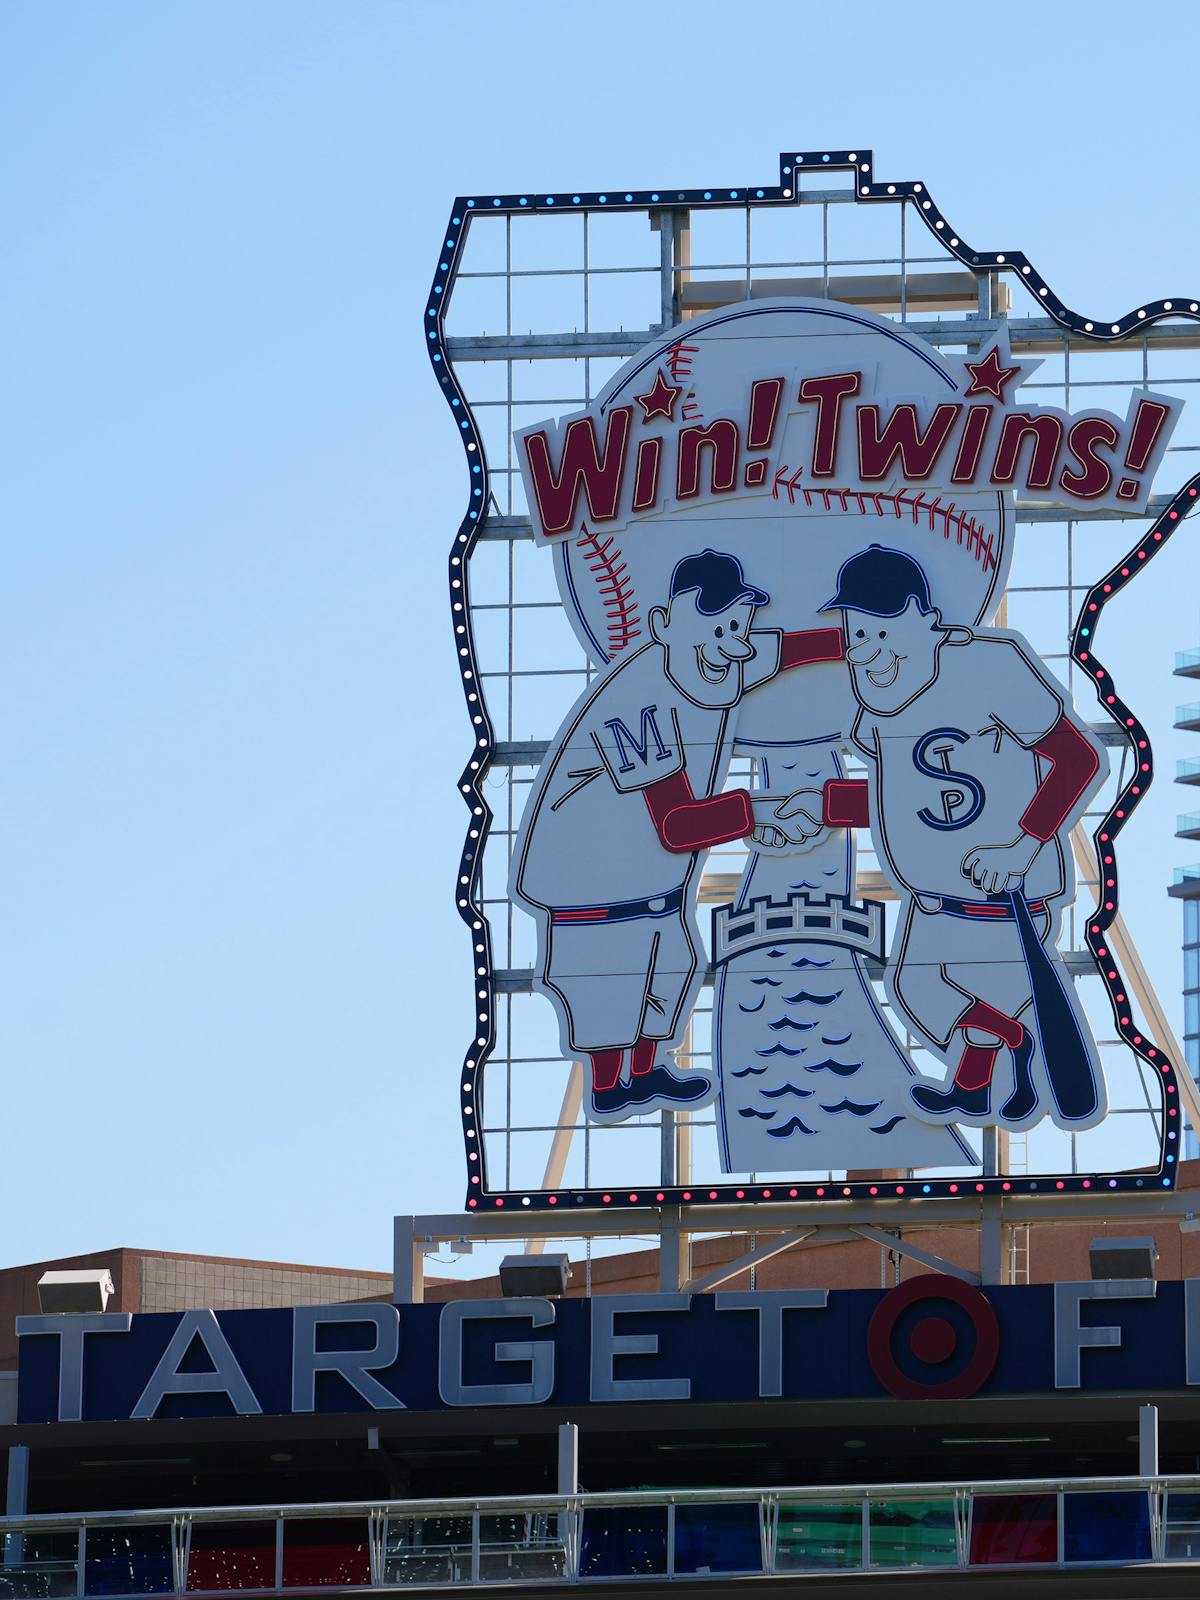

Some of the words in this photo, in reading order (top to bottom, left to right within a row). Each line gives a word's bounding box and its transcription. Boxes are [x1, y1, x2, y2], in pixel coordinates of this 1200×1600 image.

[523, 370, 786, 537] Win!
[798, 346, 1171, 501] Twins!
[604, 705, 673, 774] M
[15, 1288, 829, 1422] TARGET
